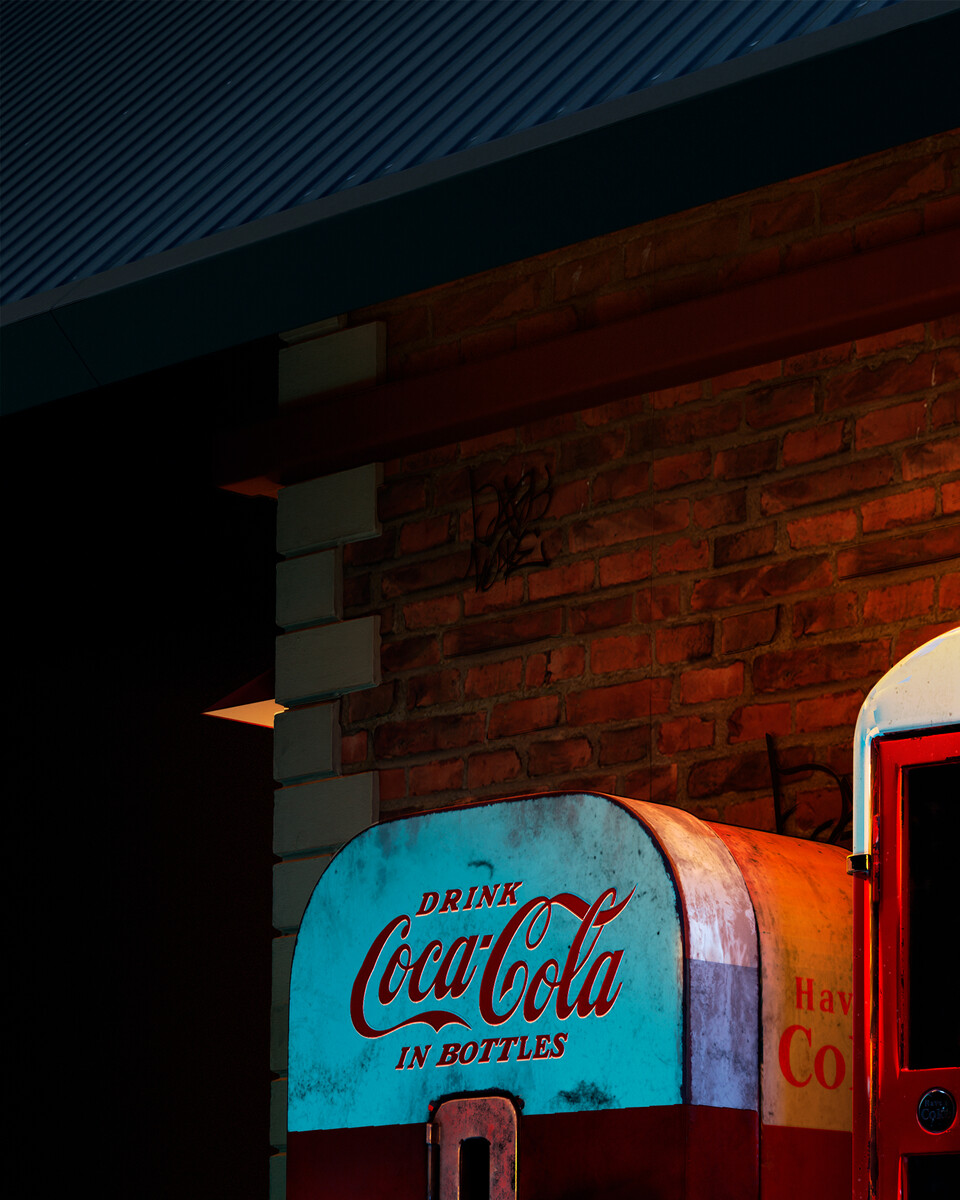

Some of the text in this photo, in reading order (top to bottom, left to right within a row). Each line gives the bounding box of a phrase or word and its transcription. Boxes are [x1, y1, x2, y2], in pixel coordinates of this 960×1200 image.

[415, 881, 524, 918] DRINK
[350, 884, 638, 1039] Coca-Cola
[795, 977, 853, 1016] Hav
[395, 1033, 569, 1071] IN BOTTLES
